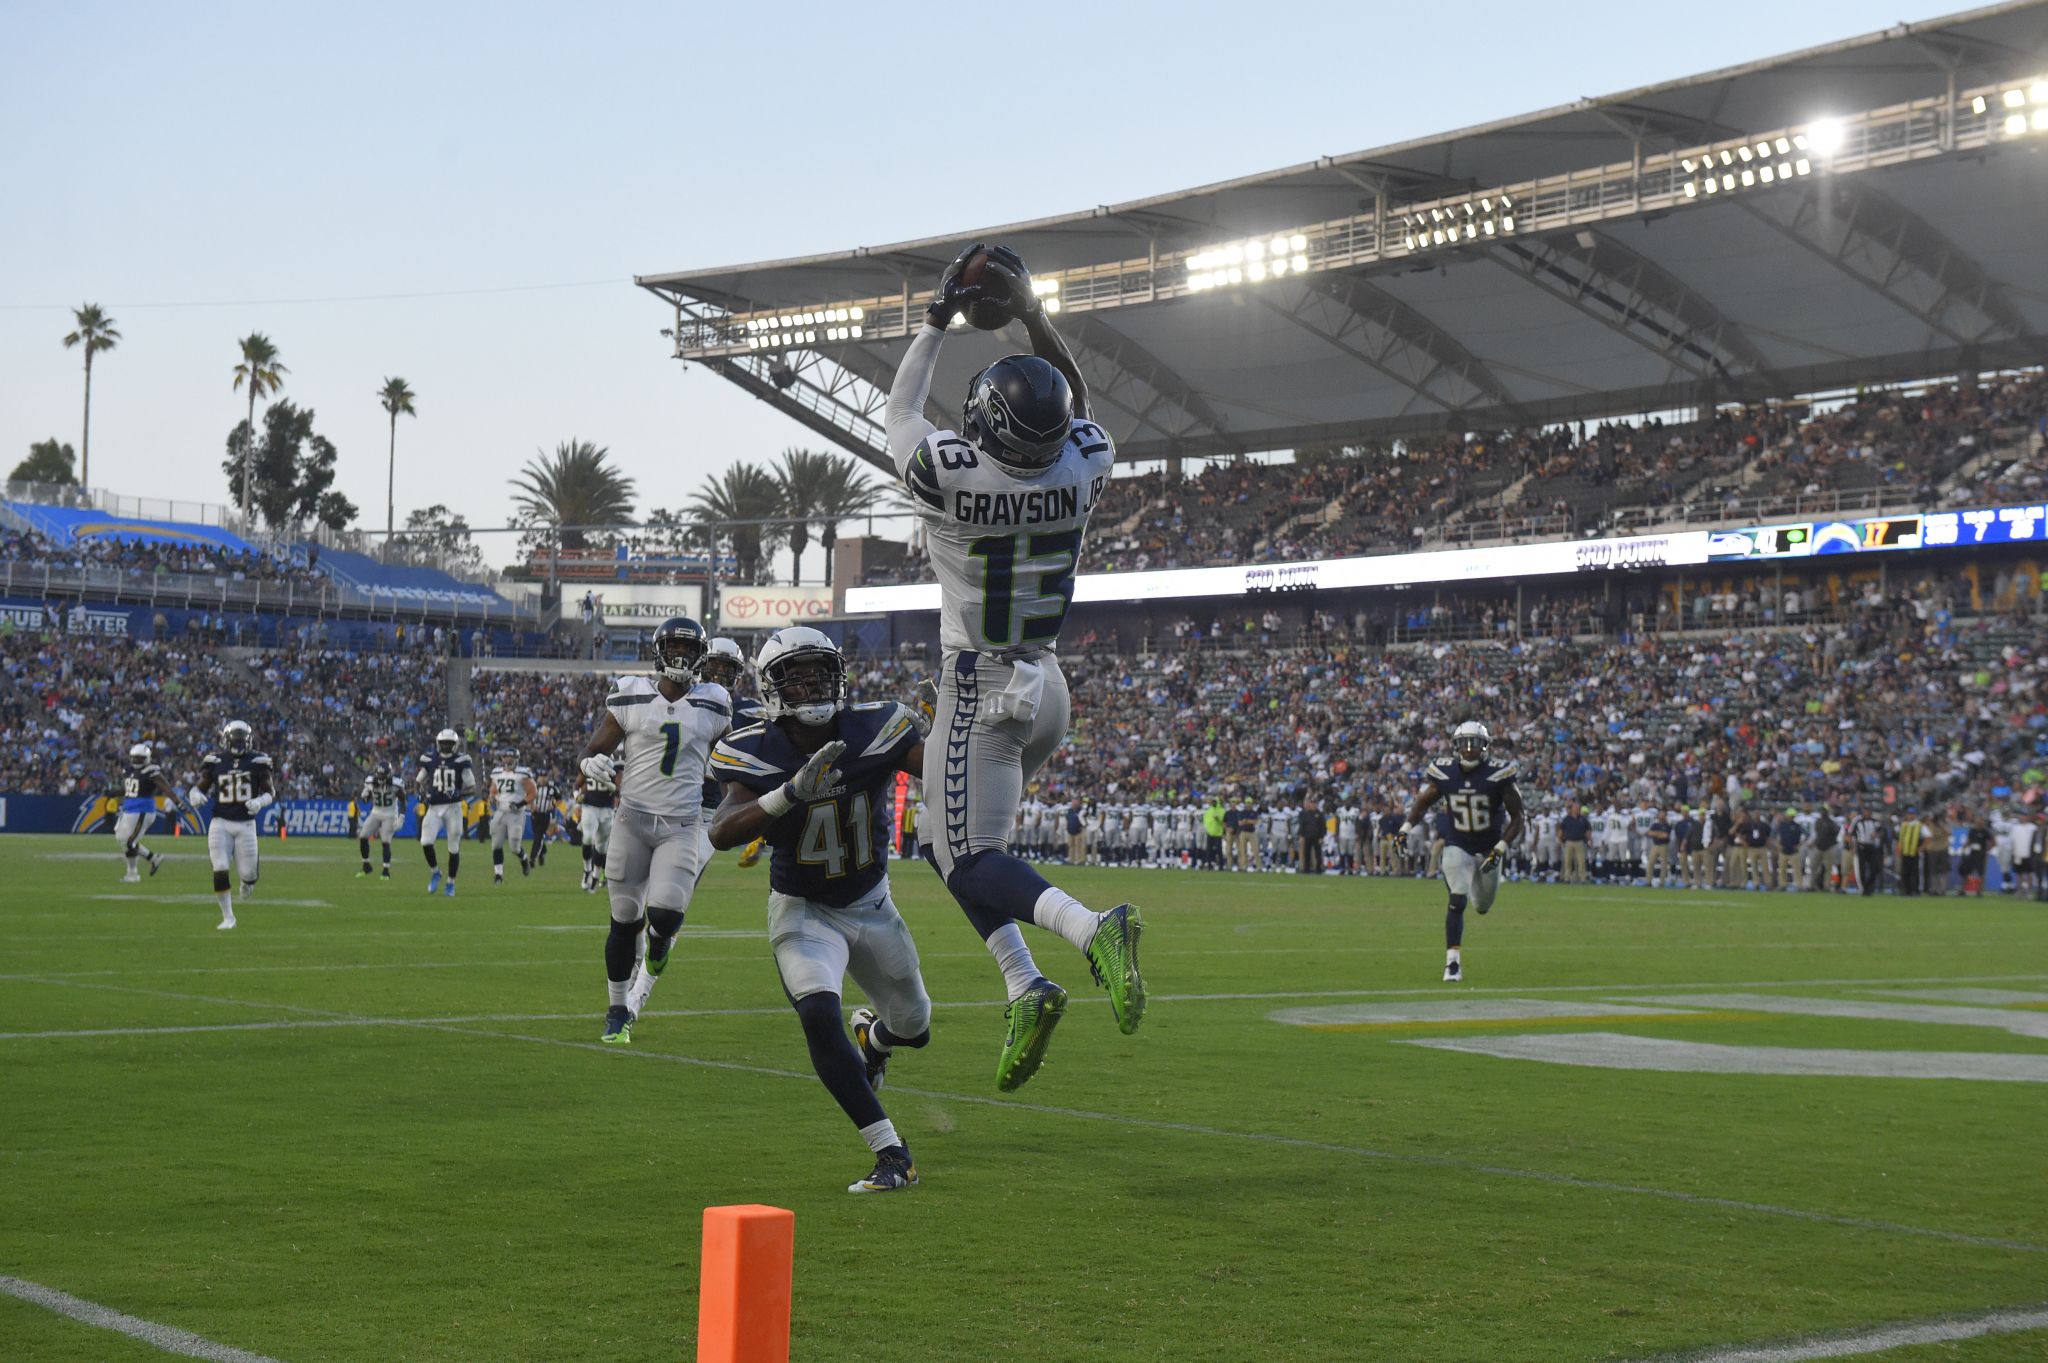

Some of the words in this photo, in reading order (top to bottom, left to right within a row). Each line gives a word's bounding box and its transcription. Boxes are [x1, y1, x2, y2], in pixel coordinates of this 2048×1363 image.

[936, 438, 980, 470] 13
[954, 486, 1078, 526] GRAYSON
[1863, 522, 1889, 547] 17
[968, 526, 1084, 646] 13
[594, 603, 686, 617] RAFTKINGS
[762, 599, 832, 616] TOYOT
[659, 721, 681, 778] 1
[218, 772, 251, 803] 36
[1449, 793, 1491, 832] 56
[798, 791, 874, 879] 41
